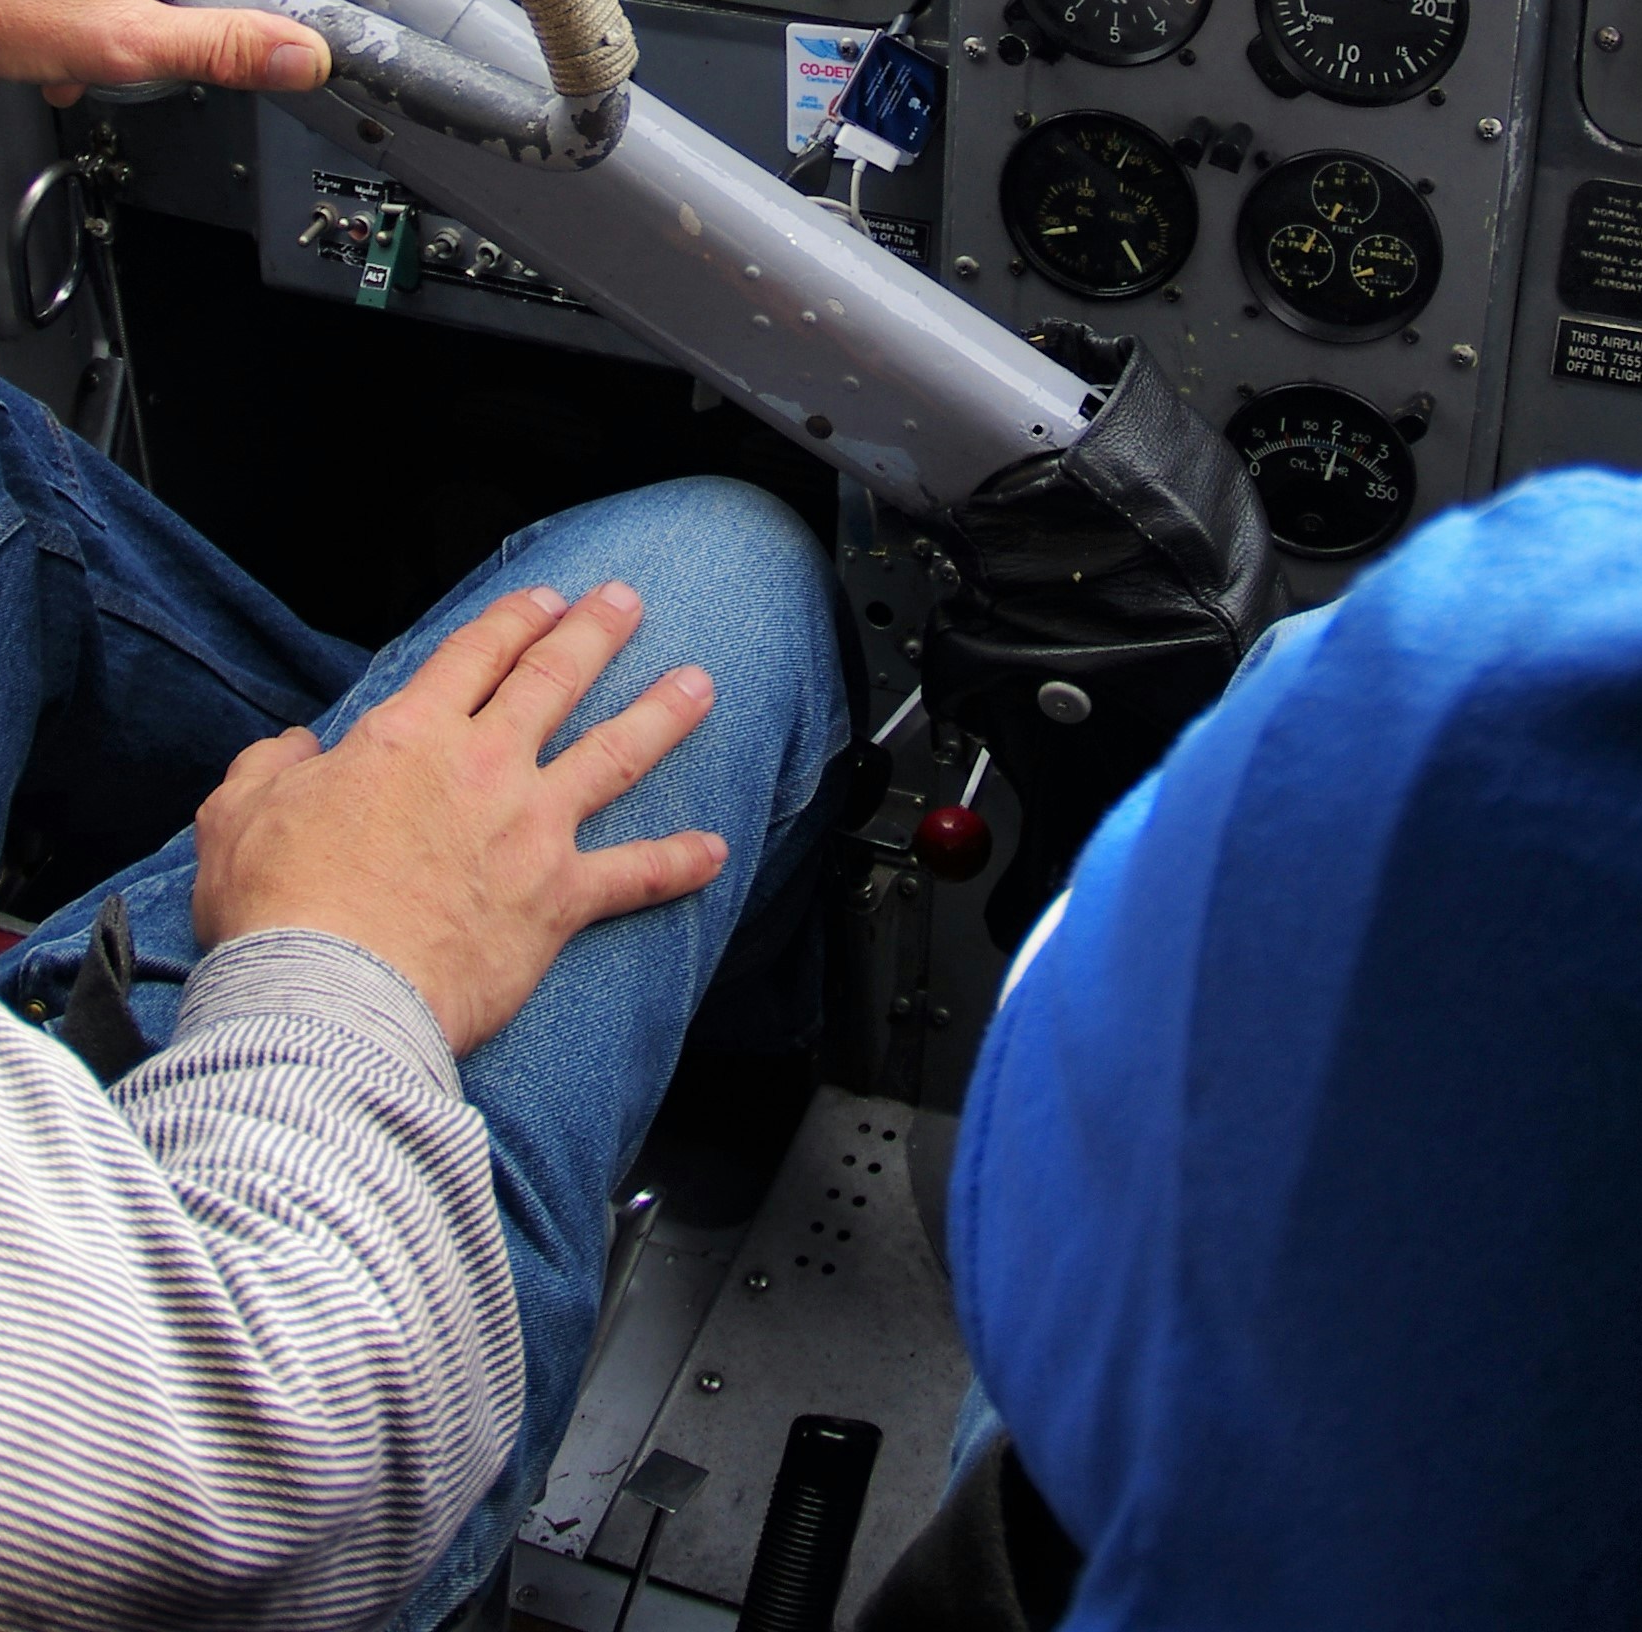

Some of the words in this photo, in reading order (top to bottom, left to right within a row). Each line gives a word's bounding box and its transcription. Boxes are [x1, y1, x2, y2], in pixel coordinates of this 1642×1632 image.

[1338, 43, 1361, 62] 10
[1396, 45, 1408, 58] 15
[1077, 206, 1093, 217] OIL
[897, 222, 916, 236] The
[1332, 225, 1354, 234] FUEL
[894, 235, 914, 247] This
[1370, 251, 1400, 260] MIDDLE
[365, 271, 385, 282] ALT
[1571, 330, 1597, 344] THIS
[1568, 346, 1607, 362] MODEL
[1567, 361, 1588, 372] OFF
[1593, 365, 1605, 376] IN
[1366, 482, 1398, 501] 350
